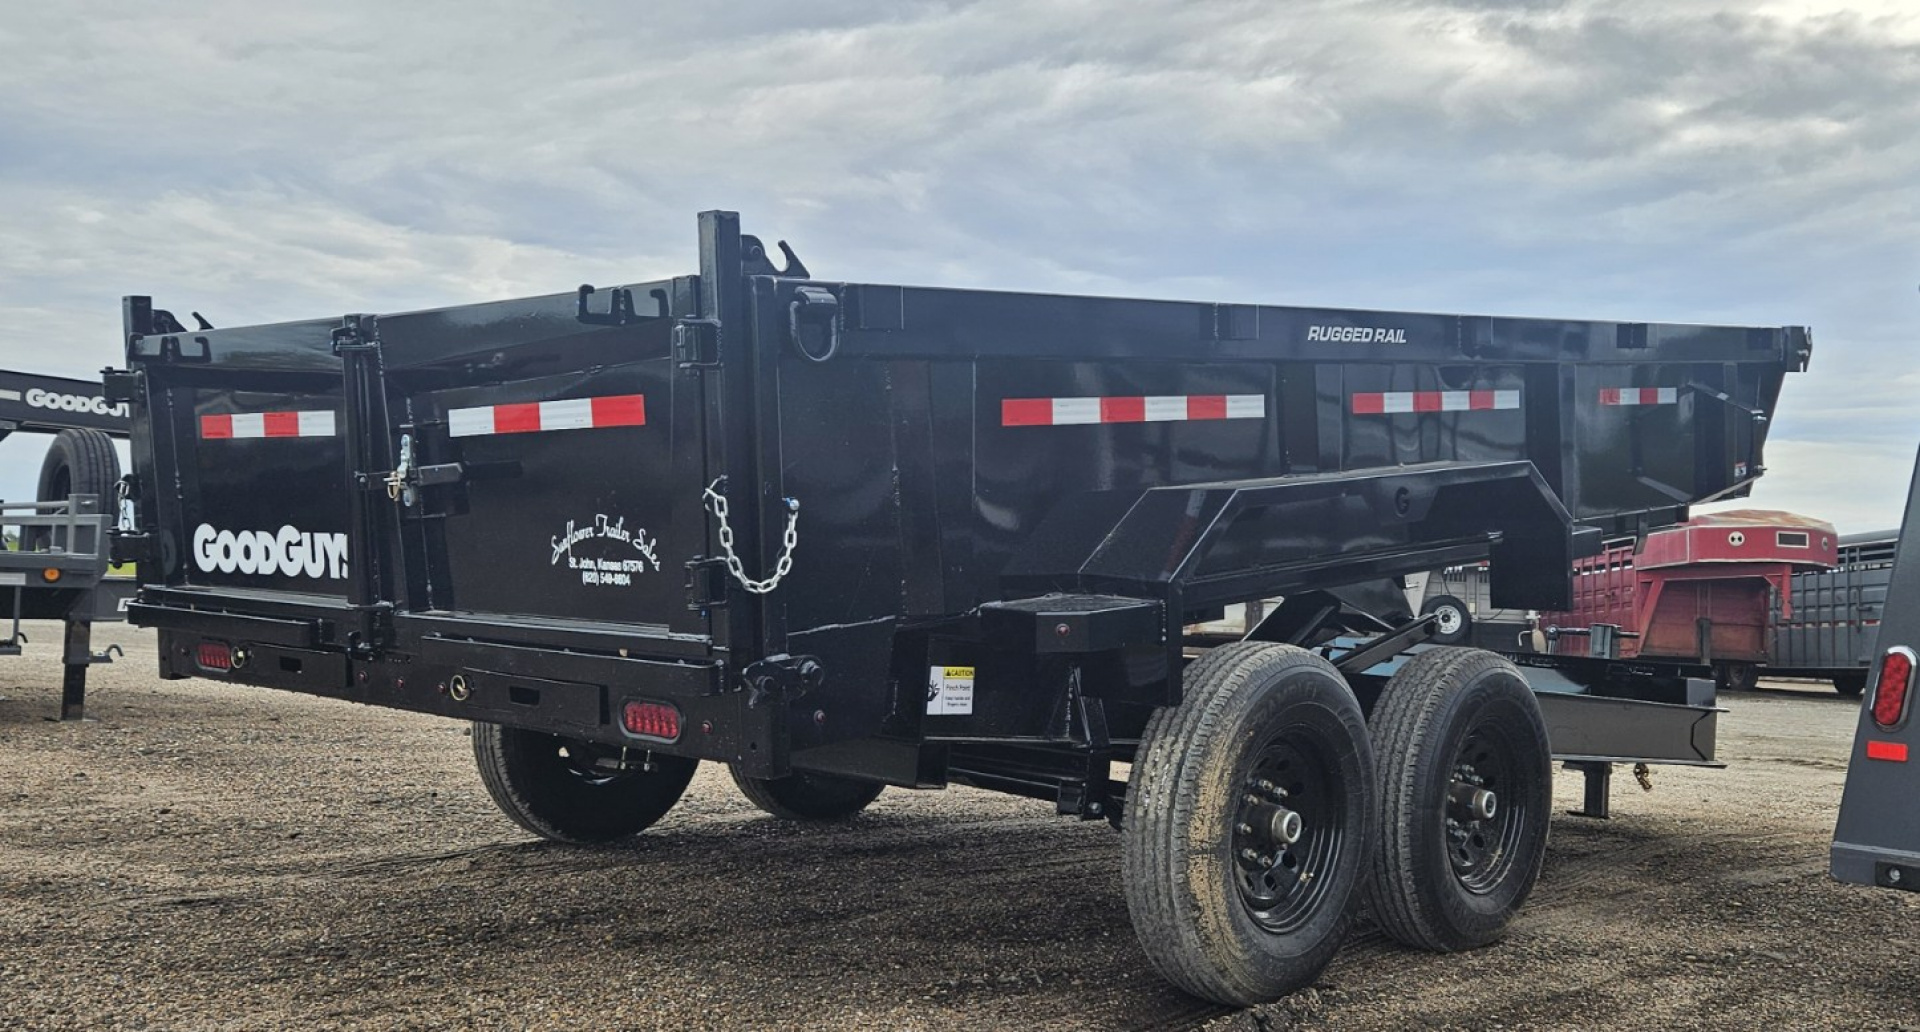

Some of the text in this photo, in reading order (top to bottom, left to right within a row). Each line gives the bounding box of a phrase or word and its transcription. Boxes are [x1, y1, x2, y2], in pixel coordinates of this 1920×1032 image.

[1307, 326, 1407, 343] RUGGED RAIL
[551, 513, 661, 572] Sunflower Trailer Sales
[597, 557, 622, 572] Kansas
